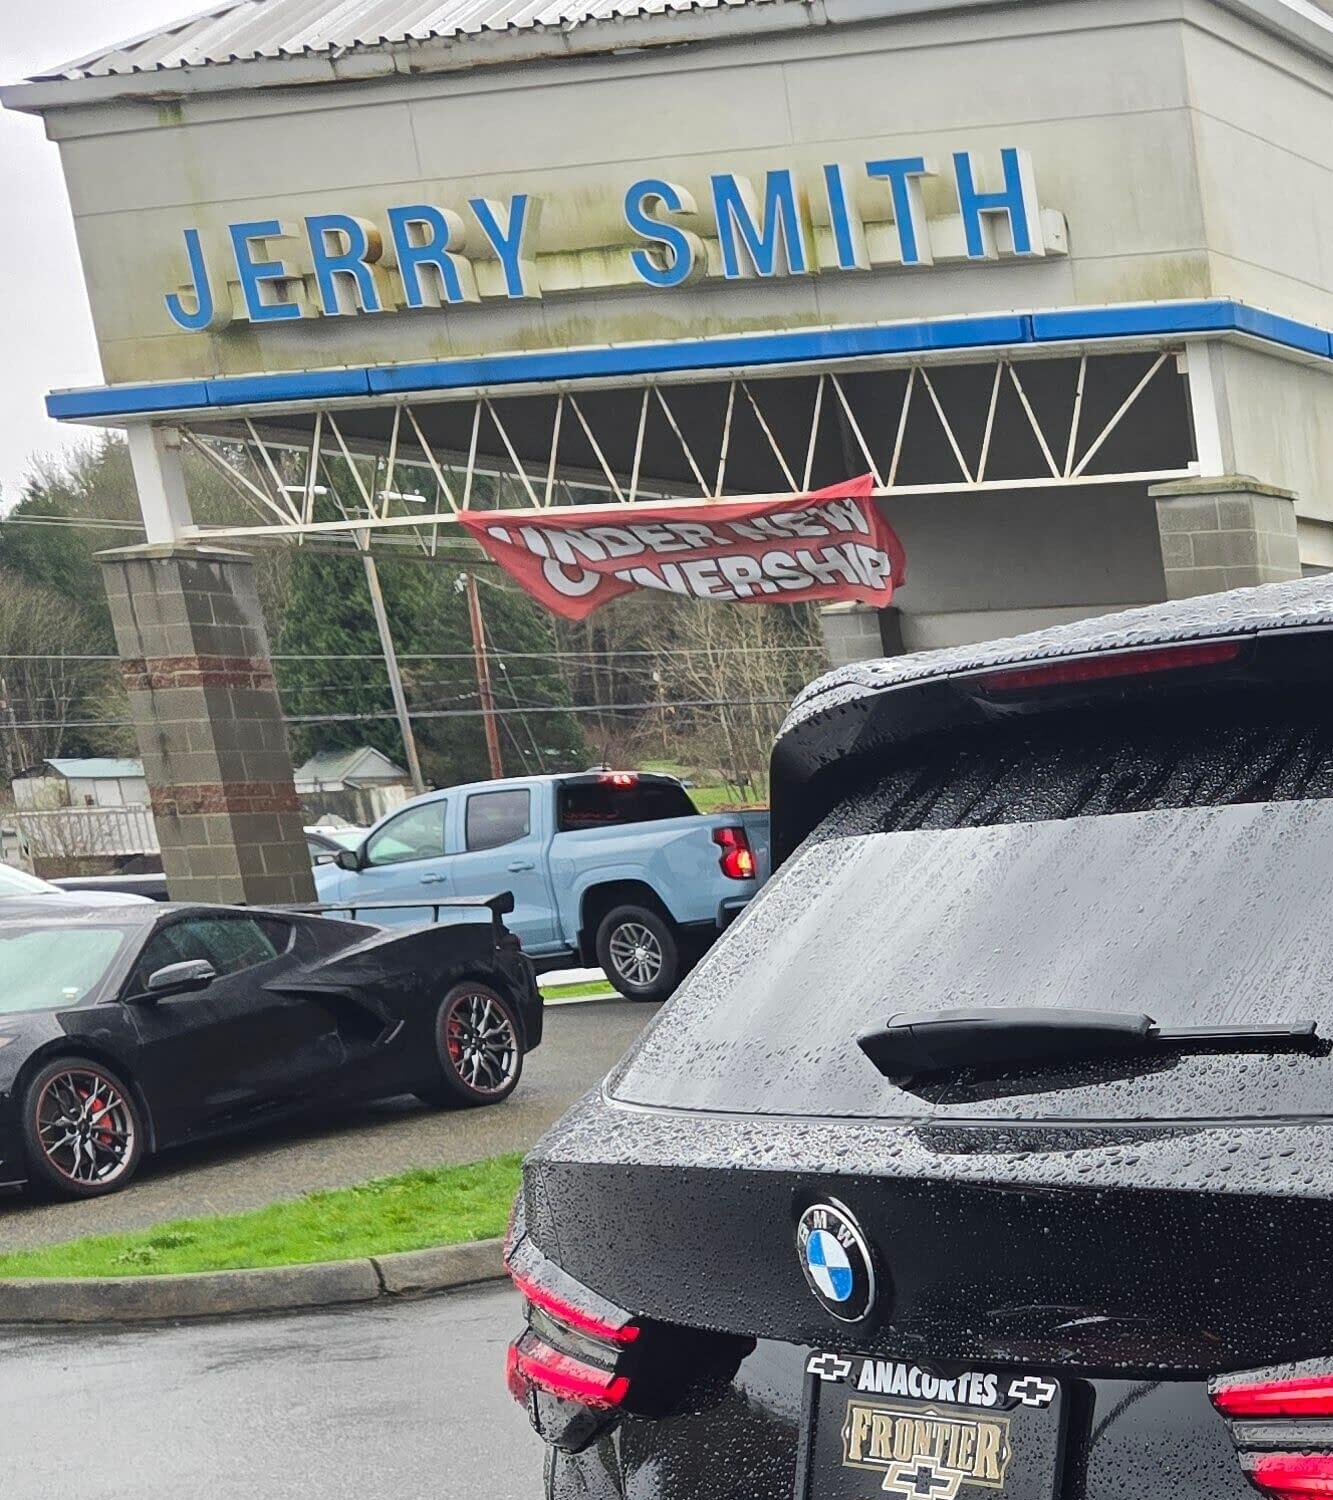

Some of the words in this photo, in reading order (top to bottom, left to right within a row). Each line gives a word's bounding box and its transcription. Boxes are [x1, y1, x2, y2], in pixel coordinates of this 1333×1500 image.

[164, 194, 540, 332] JERRY
[624, 147, 1044, 288] SMITH
[730, 497, 871, 542] NEW
[800, 1210, 856, 1248] BMW
[857, 1359, 998, 1407] ANACORTES
[848, 1407, 1002, 1479] FRONTIER
